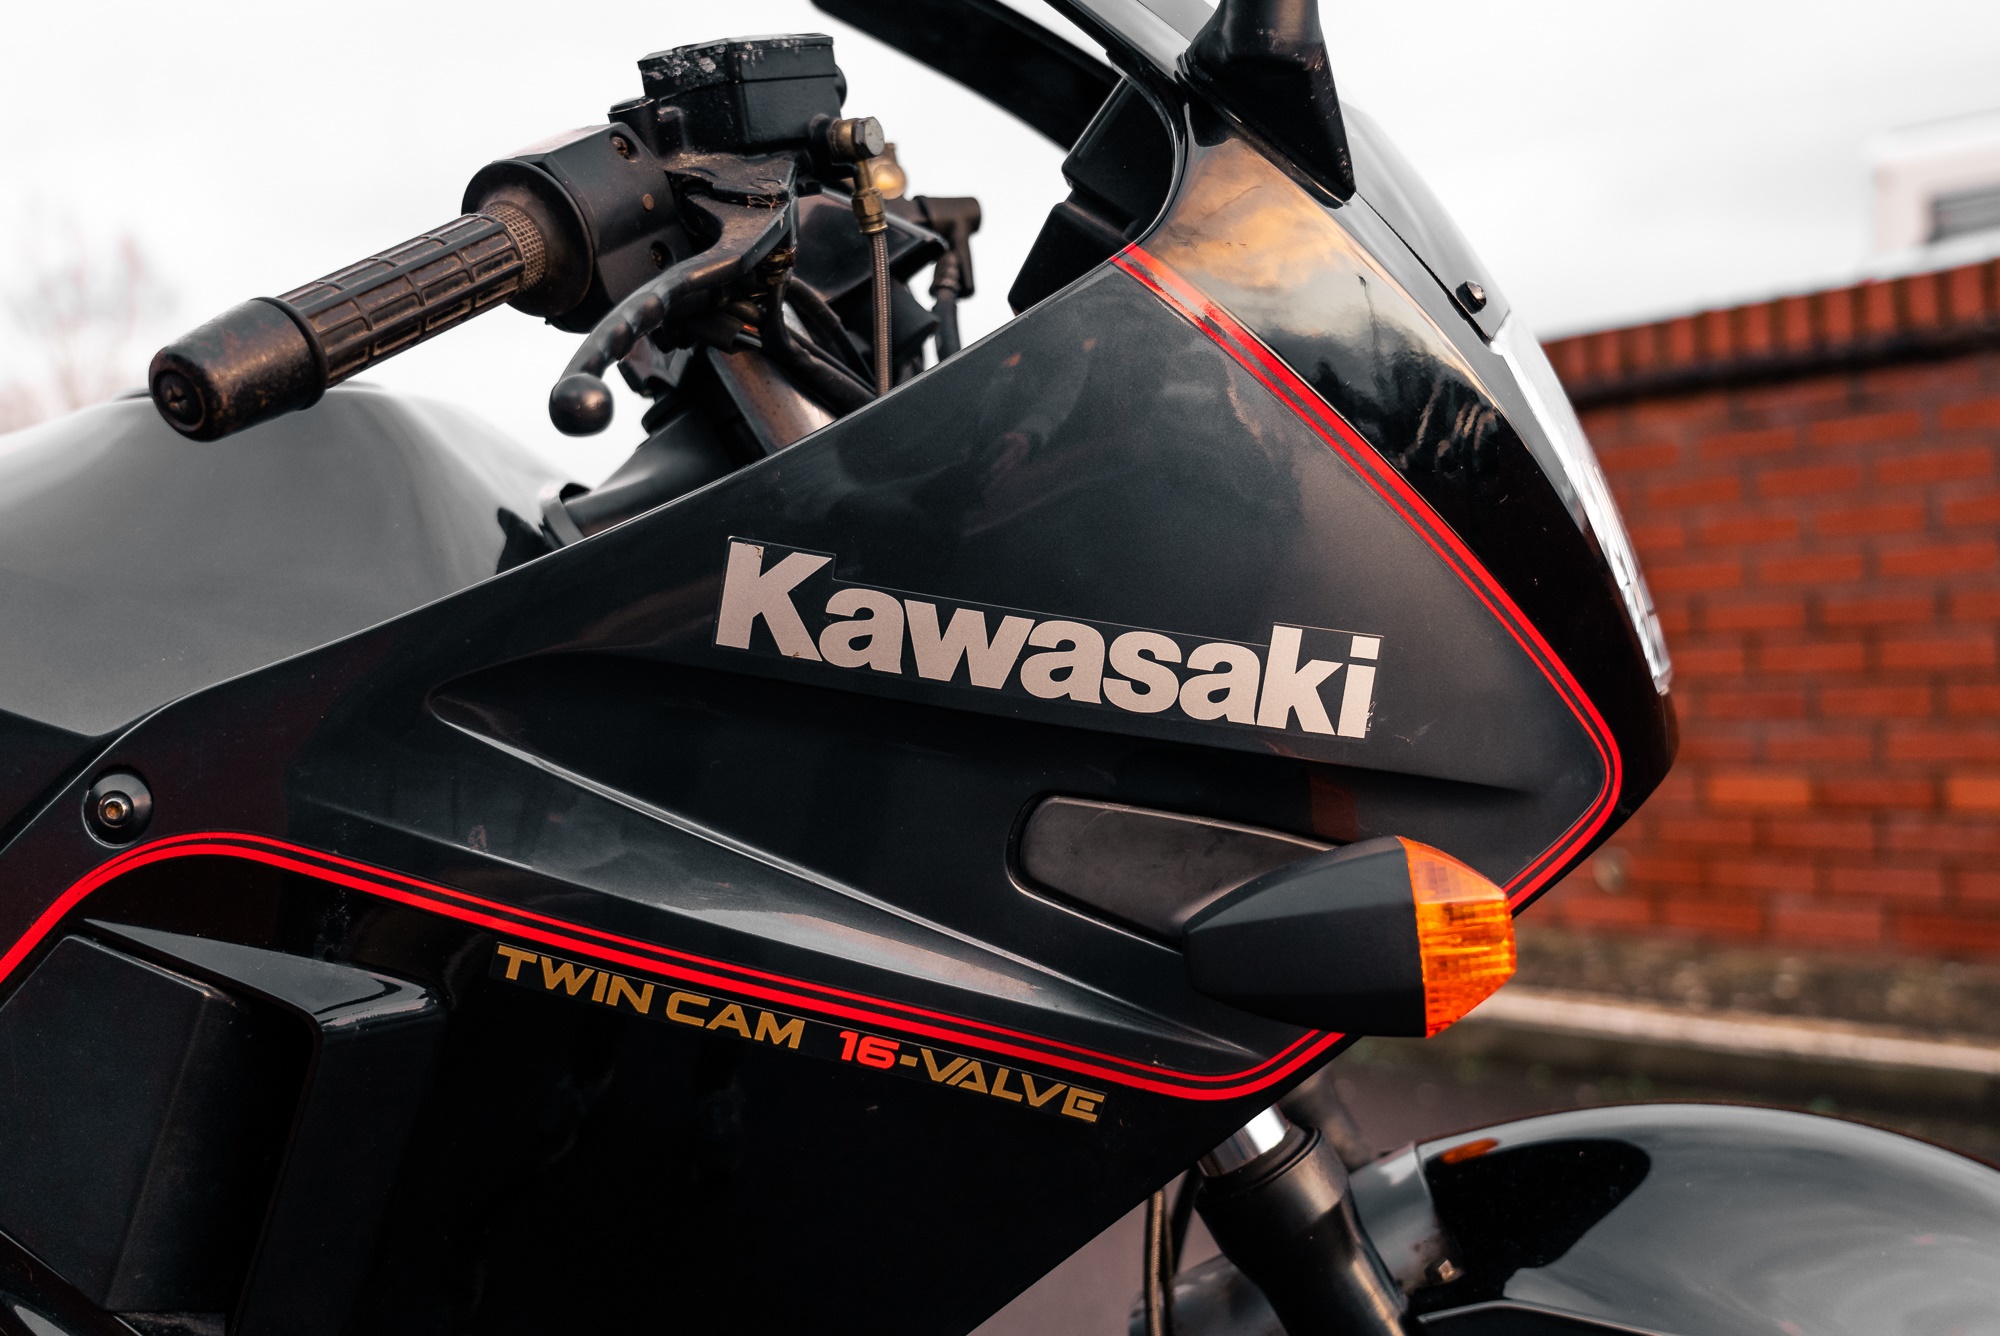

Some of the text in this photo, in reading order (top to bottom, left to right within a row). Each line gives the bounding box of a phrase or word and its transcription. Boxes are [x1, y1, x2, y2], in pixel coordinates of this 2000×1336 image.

[716, 541, 1381, 738] Kawasaki
[497, 945, 1105, 1123] TWIN CAM 16-VALVE
